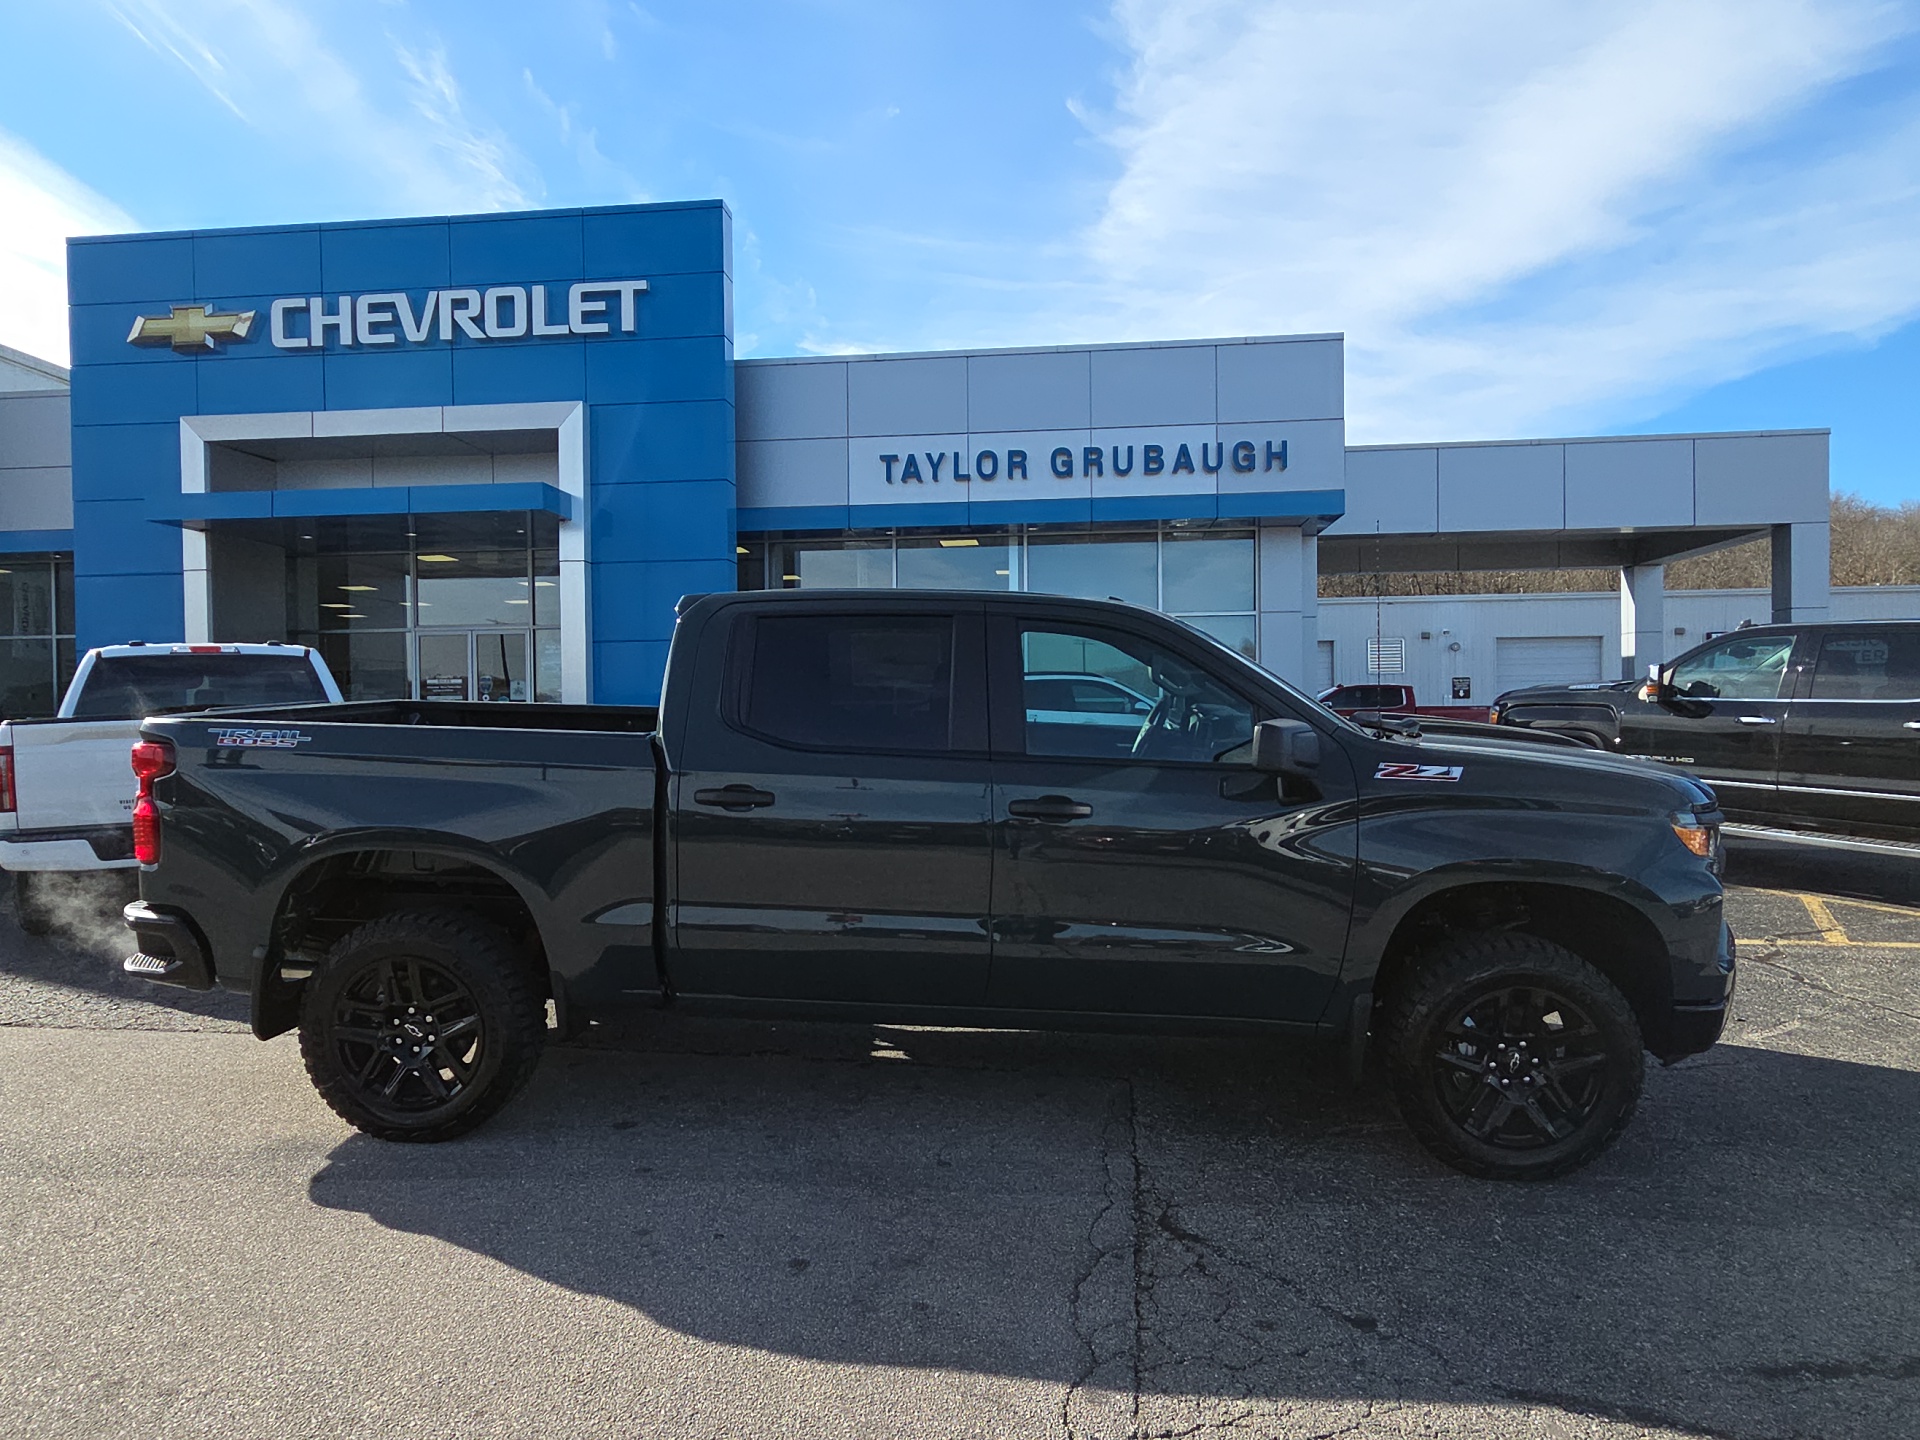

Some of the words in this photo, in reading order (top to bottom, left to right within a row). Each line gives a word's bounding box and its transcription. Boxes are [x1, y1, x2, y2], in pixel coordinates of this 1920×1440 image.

[270, 279, 648, 348] CHEVROLET
[879, 449, 1029, 484] TAYLOR
[1050, 440, 1289, 479] GRUBAUGH
[208, 728, 312, 741] TRAIL
[217, 738, 298, 748] BOSS
[1374, 762, 1464, 782] Z71
